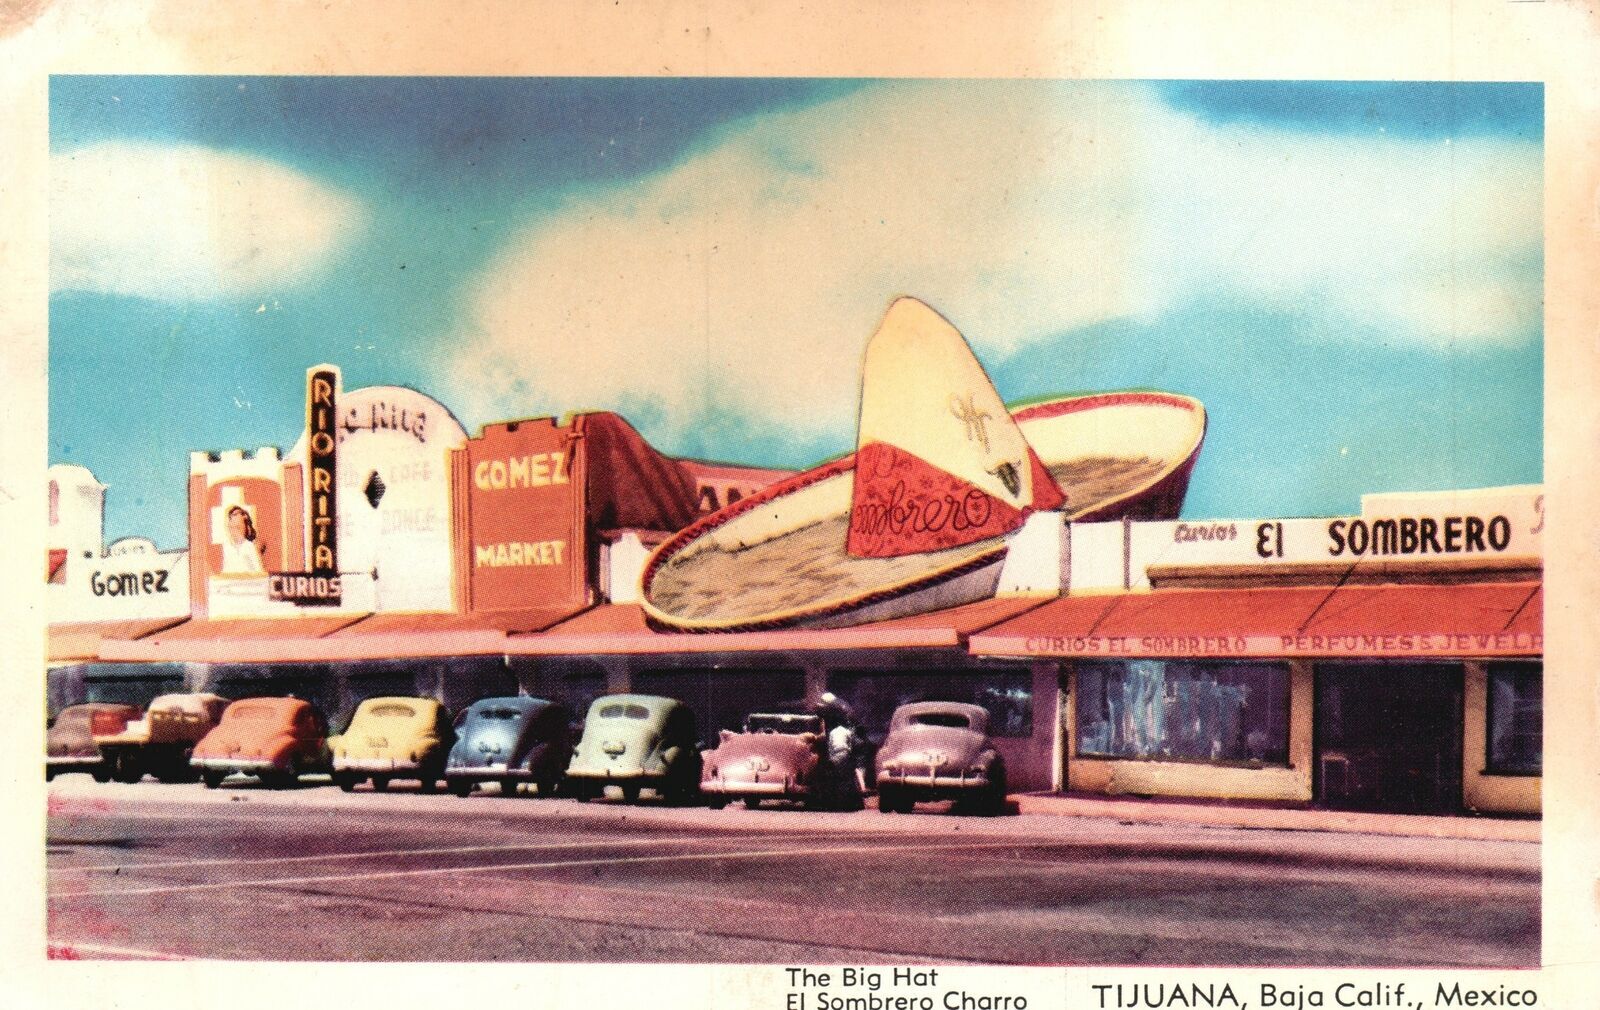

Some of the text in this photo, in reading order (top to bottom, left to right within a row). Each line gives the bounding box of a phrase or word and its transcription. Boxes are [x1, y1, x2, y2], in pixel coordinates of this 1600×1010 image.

[312, 378, 335, 569] RIO RITA
[474, 451, 570, 491] GOMEZ
[1328, 515, 1512, 557] SOMBRERO
[475, 540, 567, 568] MARKET
[91, 569, 170, 597] Gomez
[270, 575, 342, 598] CURIOS
[1025, 636, 1101, 653] CURIOS
[1108, 637, 1132, 653] EL
[1141, 636, 1248, 653] SOMBRERO
[1281, 635, 1414, 651] PERFUMES
